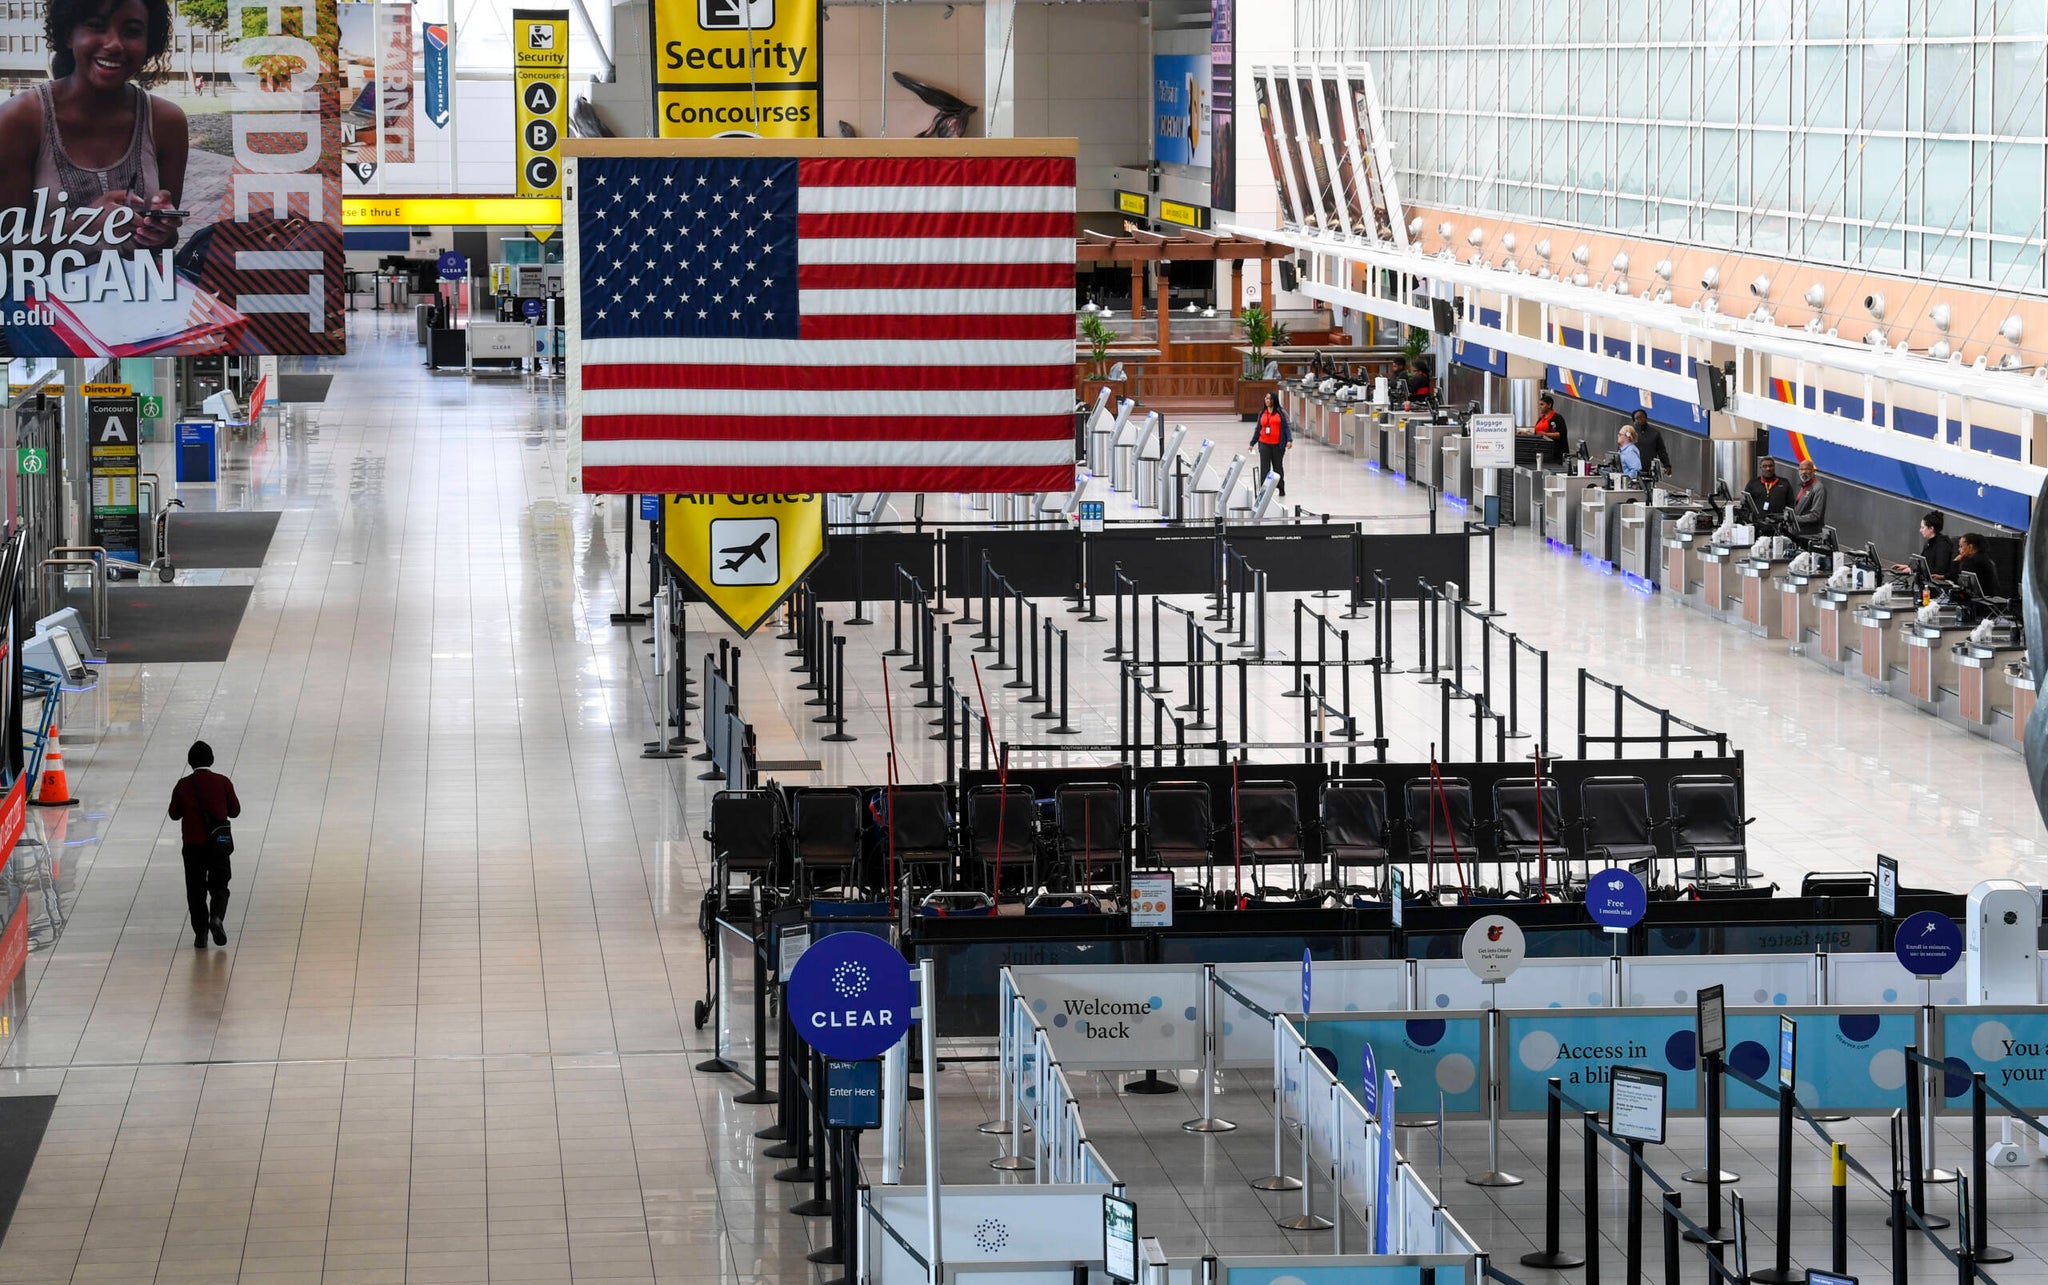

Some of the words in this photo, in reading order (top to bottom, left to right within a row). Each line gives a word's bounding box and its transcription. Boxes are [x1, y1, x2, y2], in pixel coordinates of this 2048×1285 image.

[517, 52, 564, 65] Security
[666, 39, 808, 76] Security
[517, 71, 565, 80] Concourses
[531, 89, 550, 108] A
[665, 102, 810, 123] Concourses
[384, 127, 410, 159] IT
[533, 126, 548, 145] B
[532, 163, 548, 182] C
[0, 187, 134, 246] alize
[360, 208, 367, 216] B
[370, 208, 392, 217] thru
[395, 208, 400, 216] E
[0, 249, 175, 302] RGAN
[235, 250, 325, 333] IT
[84, 385, 127, 395] Directory
[93, 405, 134, 413] Concourse
[100, 416, 128, 442] A
[727, 492, 814, 505] Gates
[1607, 899, 1625, 908] Free
[1063, 999, 1151, 1016] Welcome
[811, 1009, 893, 1028] CLEAR
[1086, 1022, 1130, 1039] back
[1556, 1042, 1623, 1059] Access
[1628, 1040, 1647, 1058] in
[2002, 1039, 2040, 1057] You
[829, 1062, 841, 1070] TSA
[1569, 1071, 1580, 1084] a
[2001, 1068, 2047, 1087] your
[829, 1088, 853, 1097] Enter
[854, 1087, 876, 1097] Here
